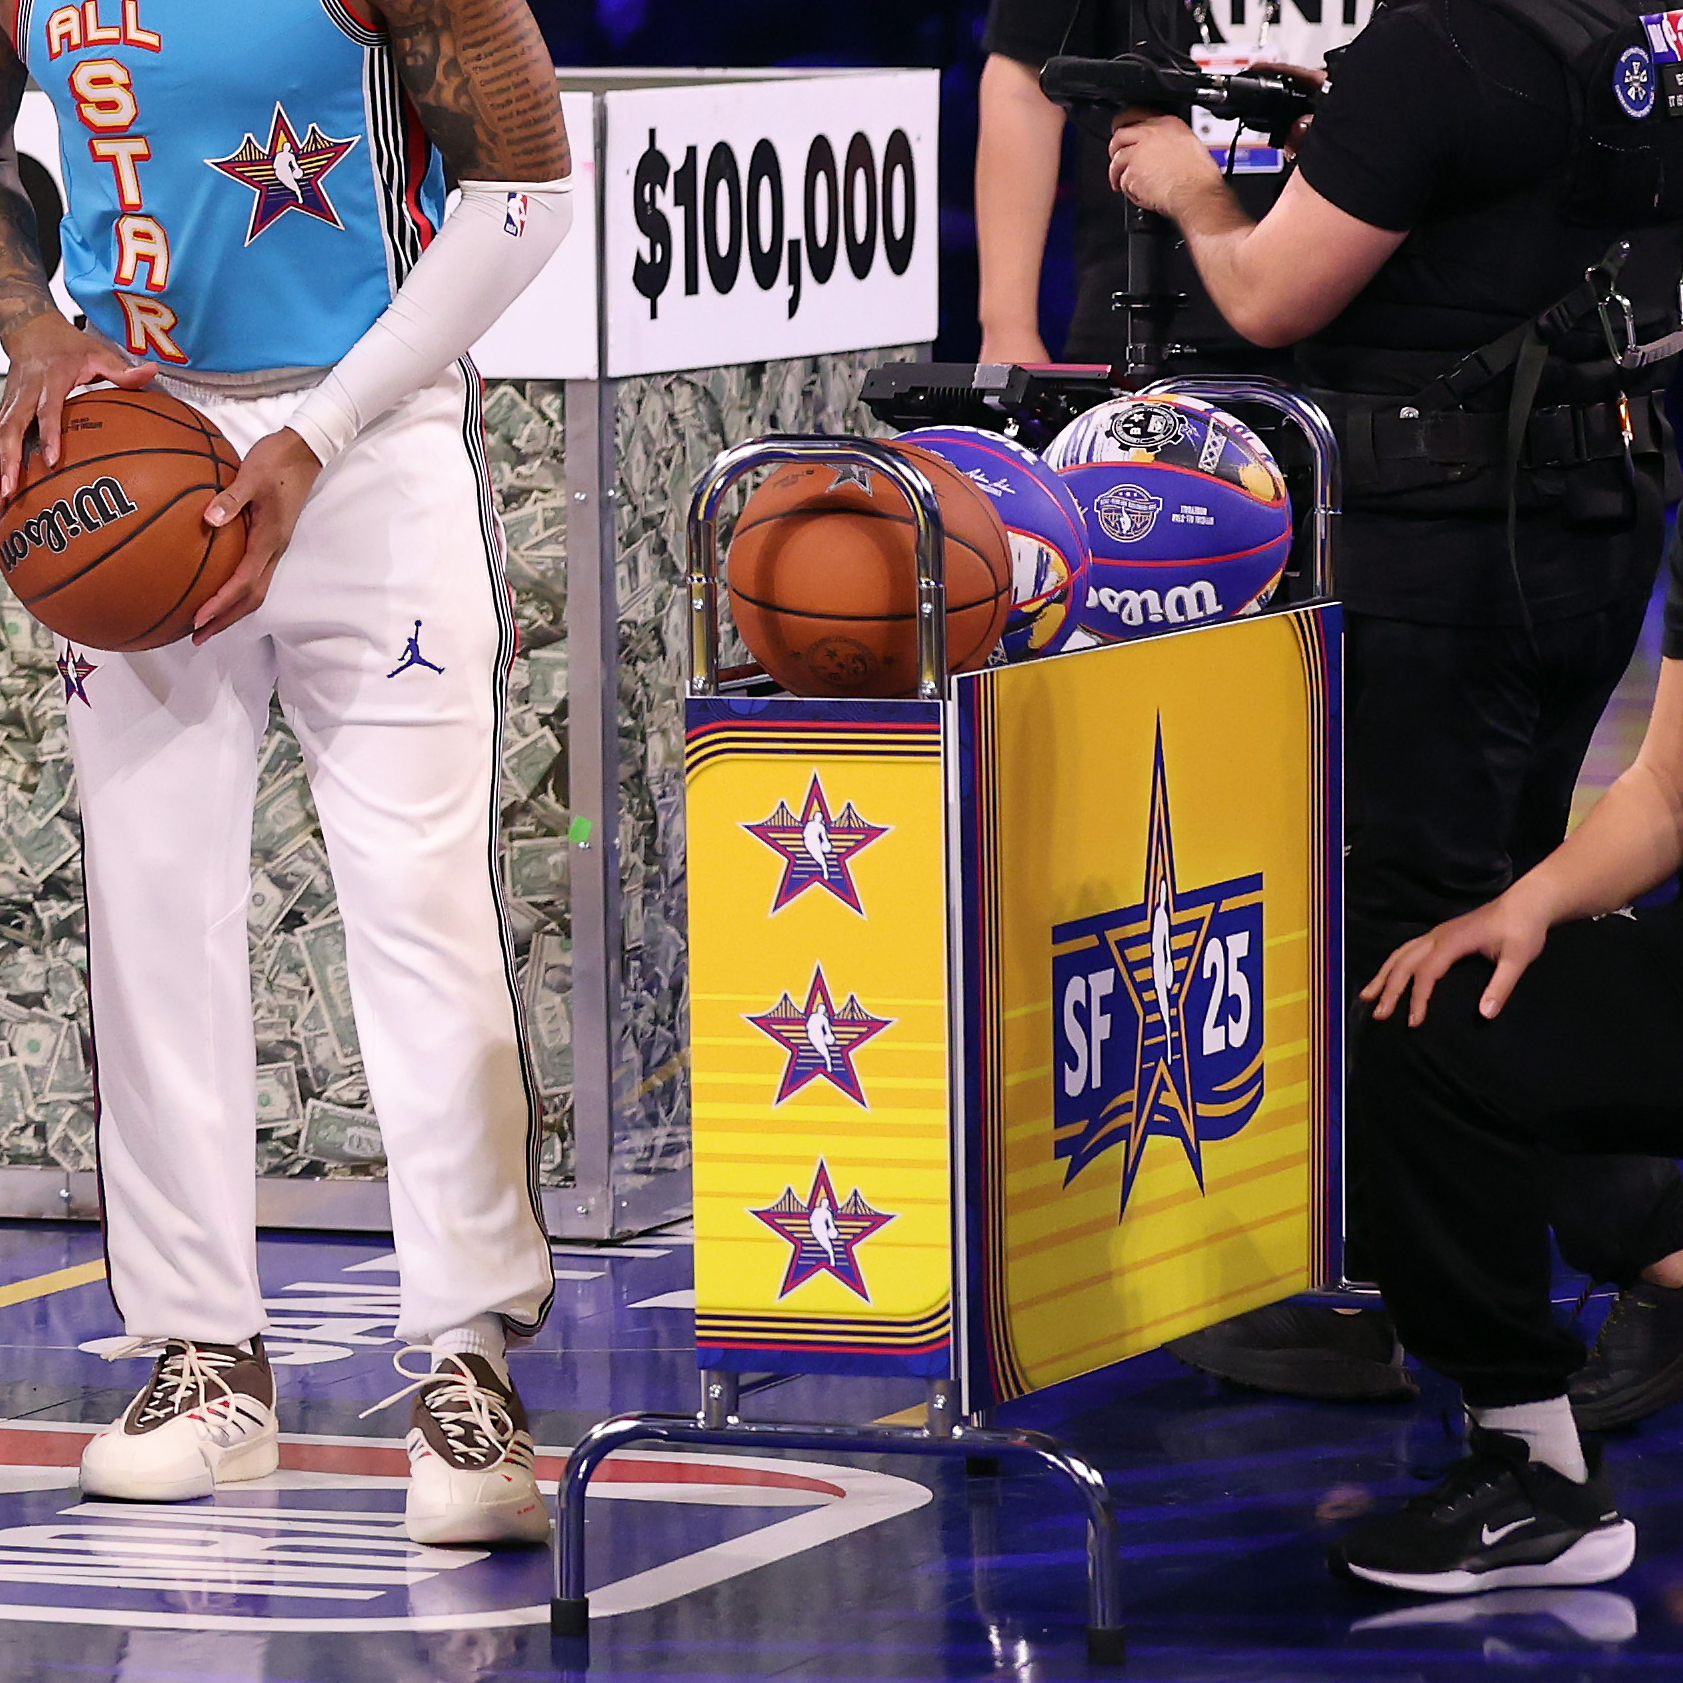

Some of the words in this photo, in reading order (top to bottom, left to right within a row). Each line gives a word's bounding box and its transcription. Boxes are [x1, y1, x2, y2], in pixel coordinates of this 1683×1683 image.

[67, 57, 190, 364] STAR
[631, 128, 917, 320] $100,000
[1062, 967, 1116, 1098] SF
[1202, 930, 1251, 1056] 25
